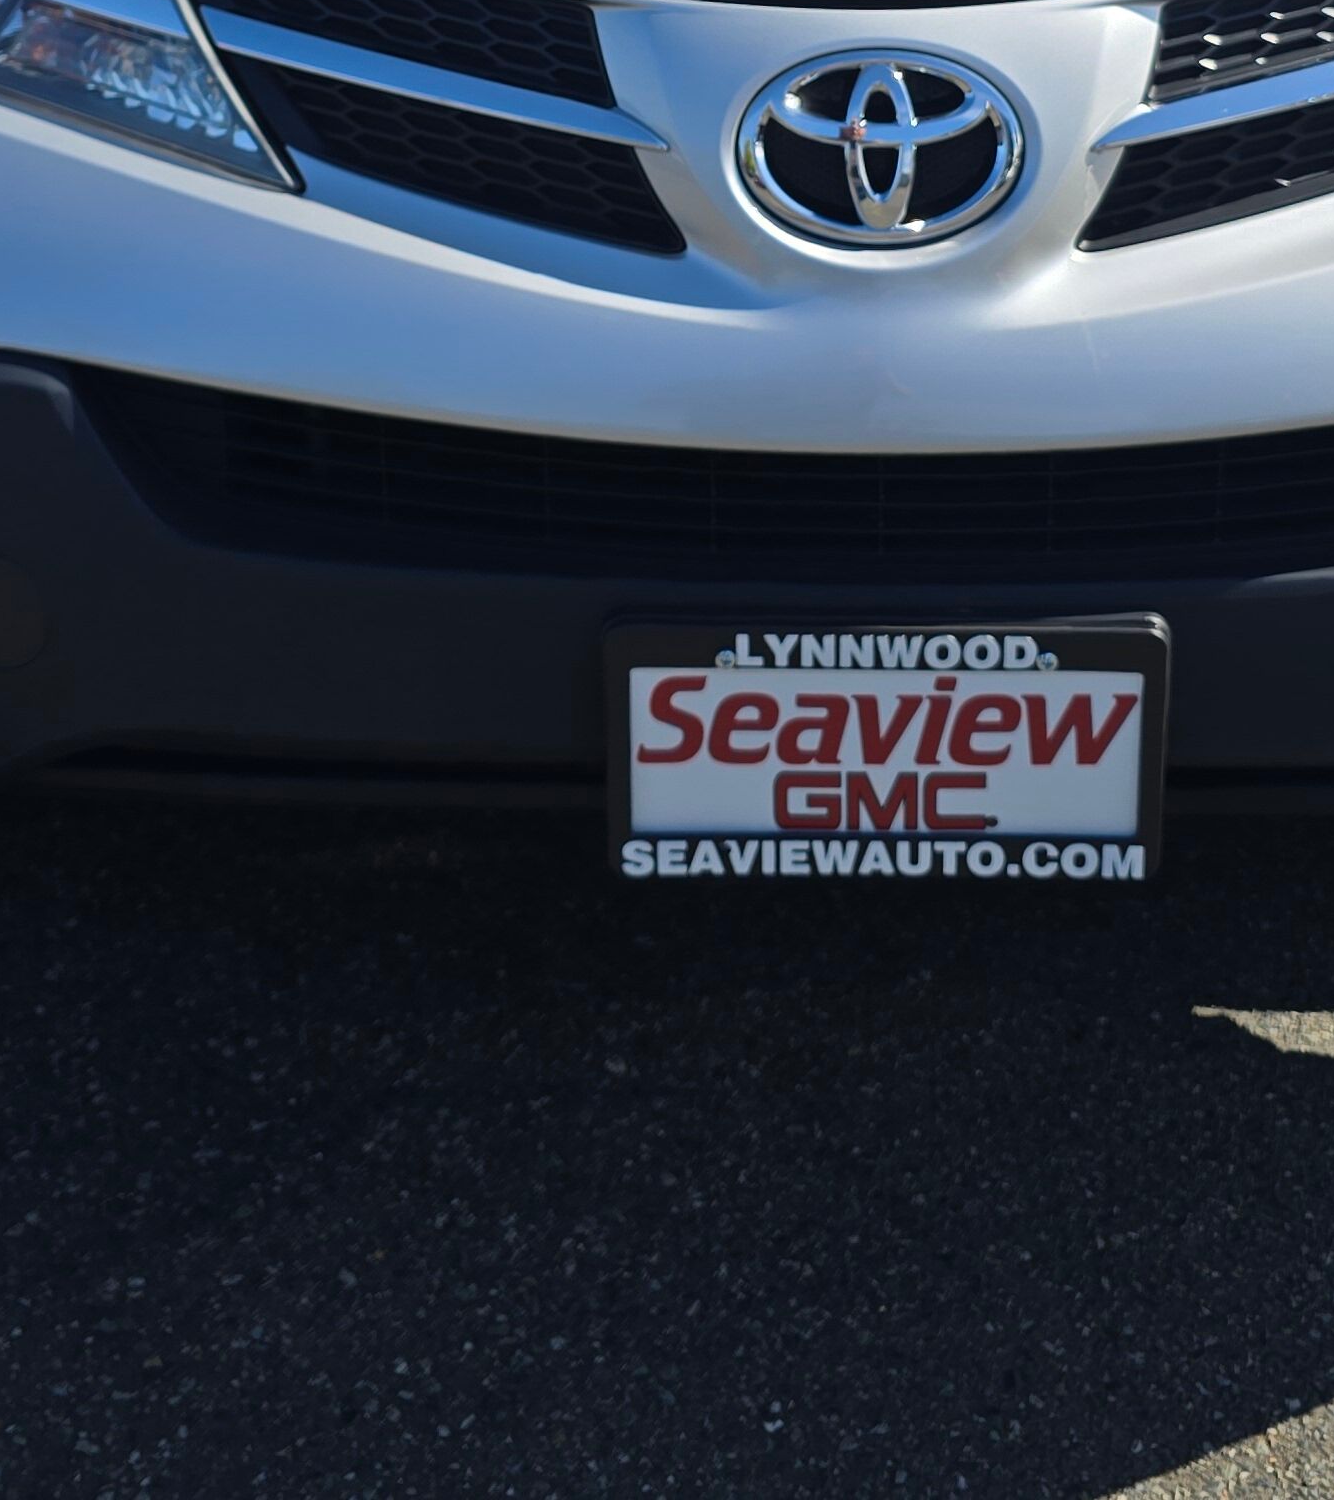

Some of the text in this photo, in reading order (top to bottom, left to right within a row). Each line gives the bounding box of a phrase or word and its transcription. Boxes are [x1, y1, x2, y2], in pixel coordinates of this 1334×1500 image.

[735, 633, 1038, 669] LYNNWOOD
[636, 674, 1139, 766] Seaview
[773, 771, 988, 831] GMC
[621, 839, 1145, 880] SEAVIEWAUTO.COM
